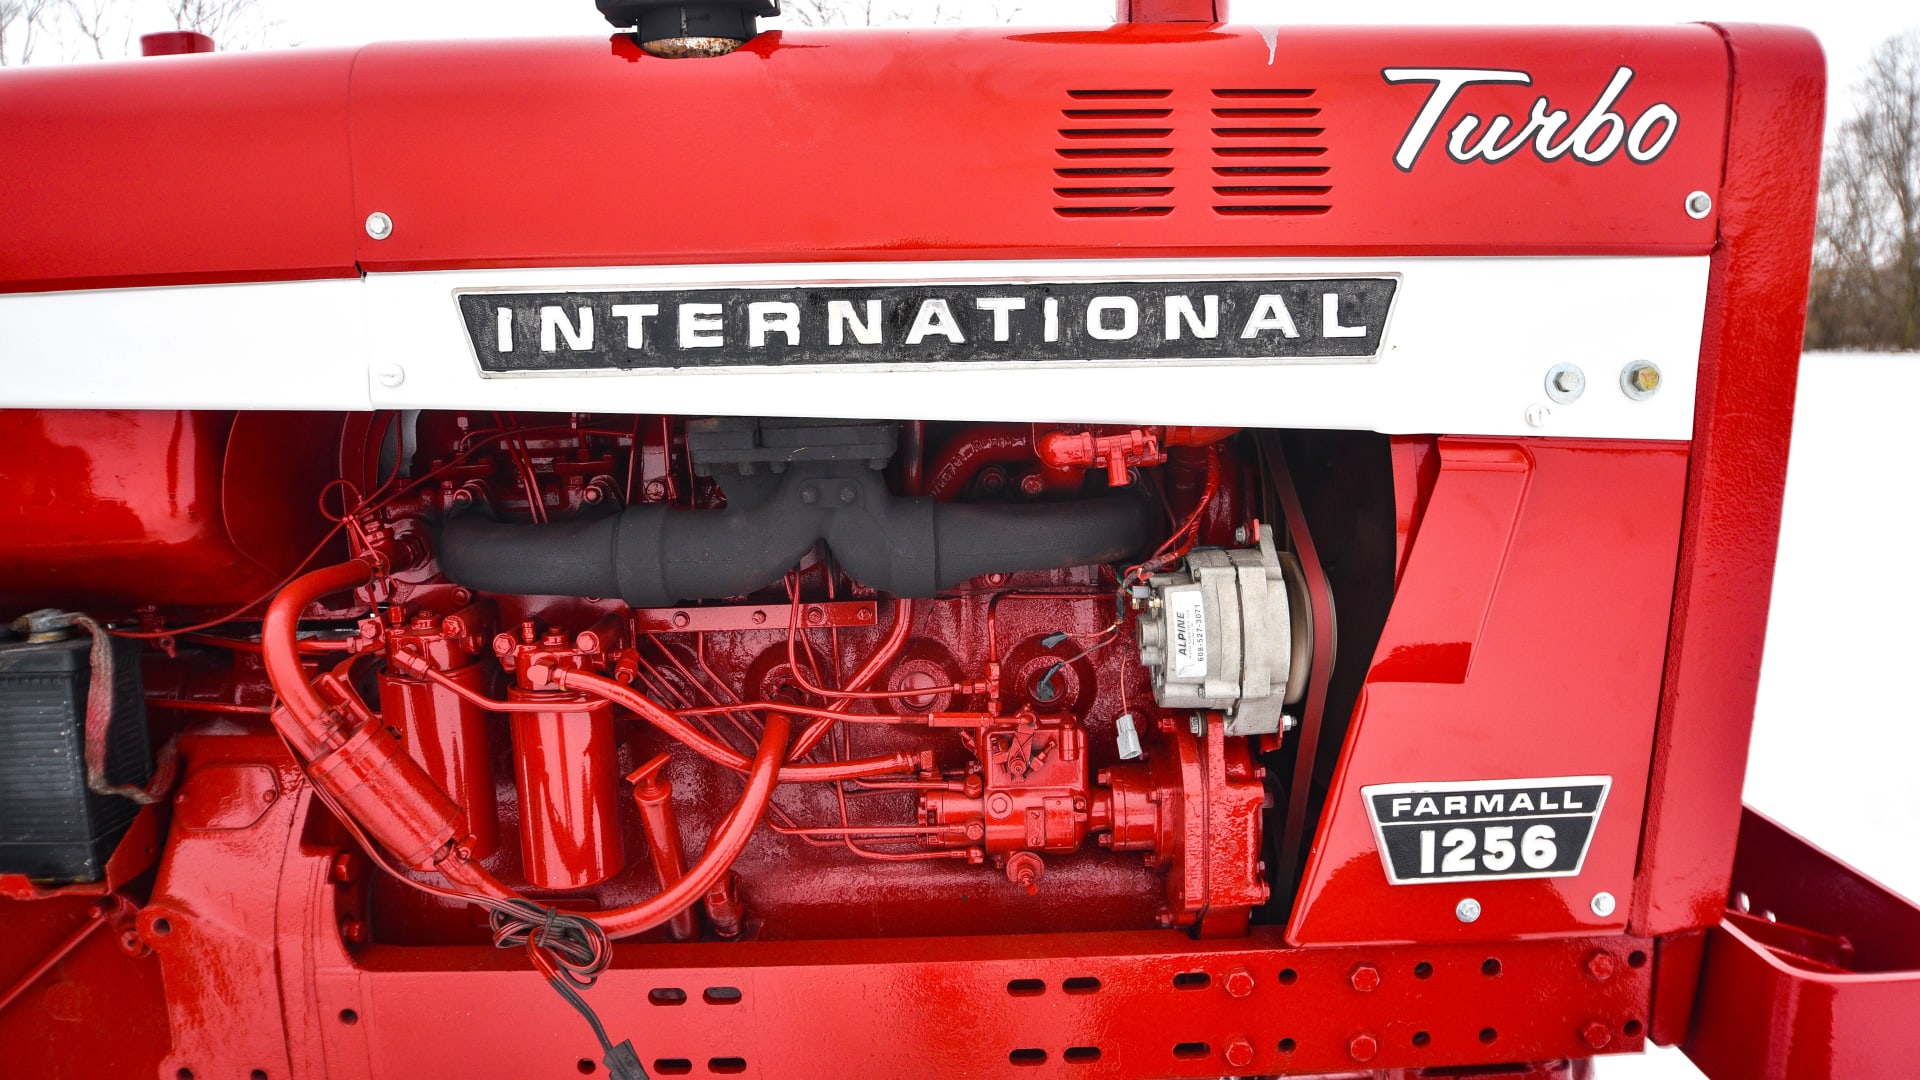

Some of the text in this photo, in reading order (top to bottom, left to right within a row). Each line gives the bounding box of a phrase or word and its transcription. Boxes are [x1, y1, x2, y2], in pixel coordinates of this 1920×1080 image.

[1381, 66, 1679, 173] Turbo
[497, 293, 1367, 352] INTERNATIONAL
[1176, 612, 1187, 656] ALPINE
[1194, 604, 1204, 662] 608-527-3071
[1392, 790, 1583, 817] FARMALL
[1420, 824, 1558, 874] 1256
